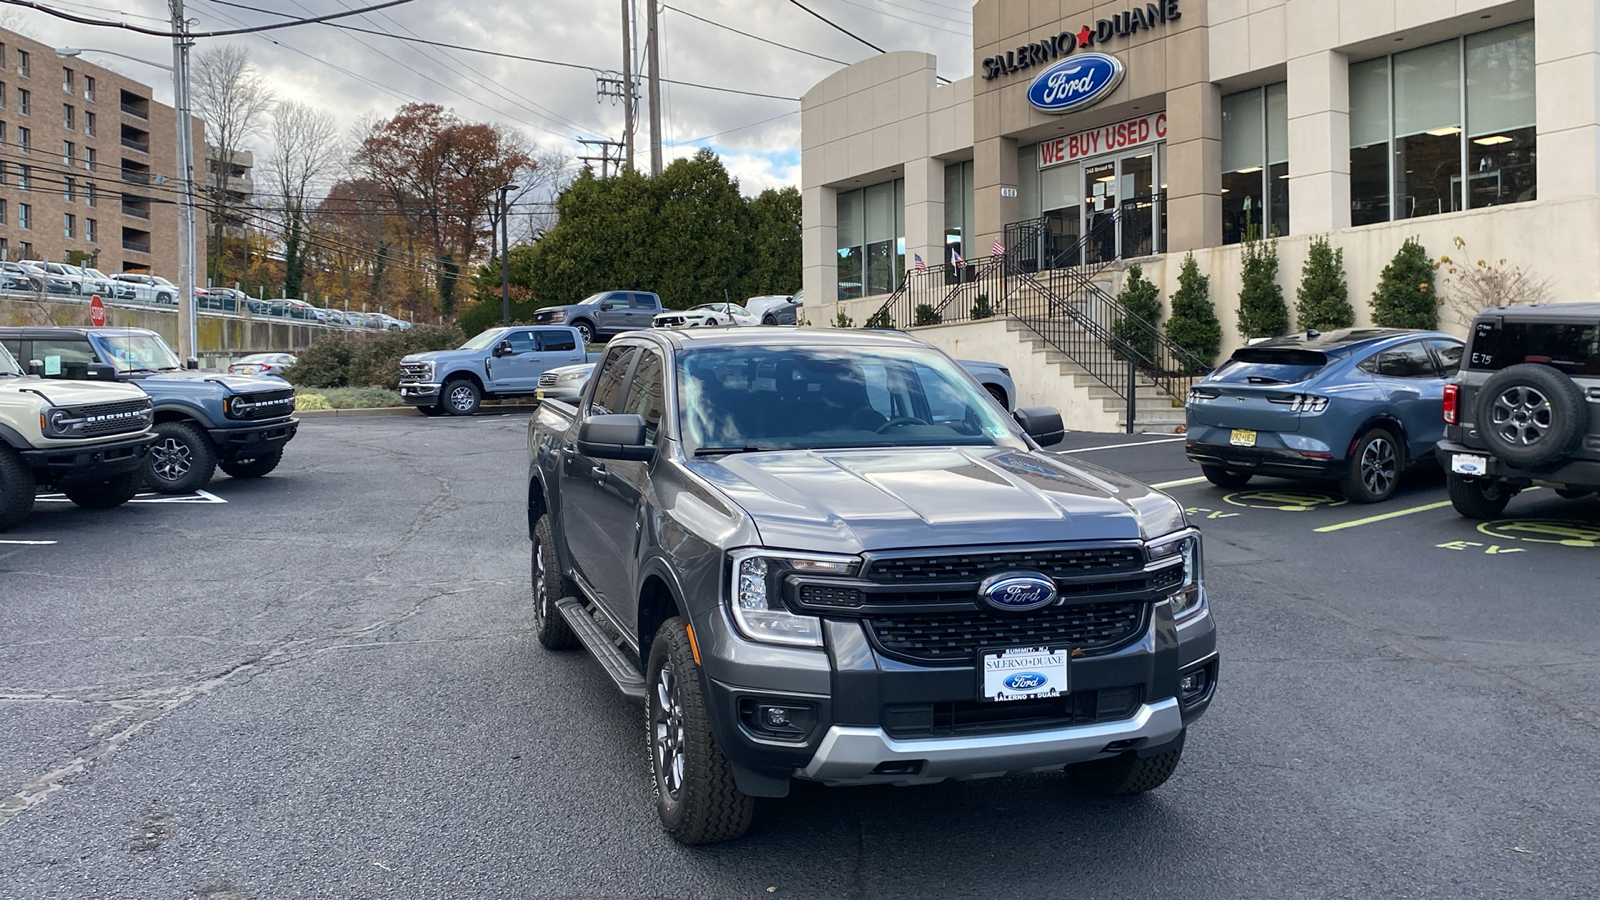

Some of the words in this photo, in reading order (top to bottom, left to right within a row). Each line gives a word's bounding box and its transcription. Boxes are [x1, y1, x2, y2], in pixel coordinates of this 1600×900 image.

[981, 31, 1076, 80] SALERNO
[1095, 0, 1181, 43] DUANE
[1043, 66, 1095, 104] Ford
[1041, 136, 1064, 165] WE
[1069, 130, 1100, 158] BUY
[1105, 118, 1149, 150] USED
[1155, 113, 1167, 138] C
[91, 306, 104, 320] STOP
[255, 399, 289, 407] BRONCO
[87, 411, 140, 422] BRONCO
[1003, 584, 1042, 603] Ford
[986, 658, 1028, 669] SALERNO
[1032, 656, 1064, 666] DUANE
[1012, 674, 1039, 688] Ford
[994, 693, 1027, 702] SALERNO
